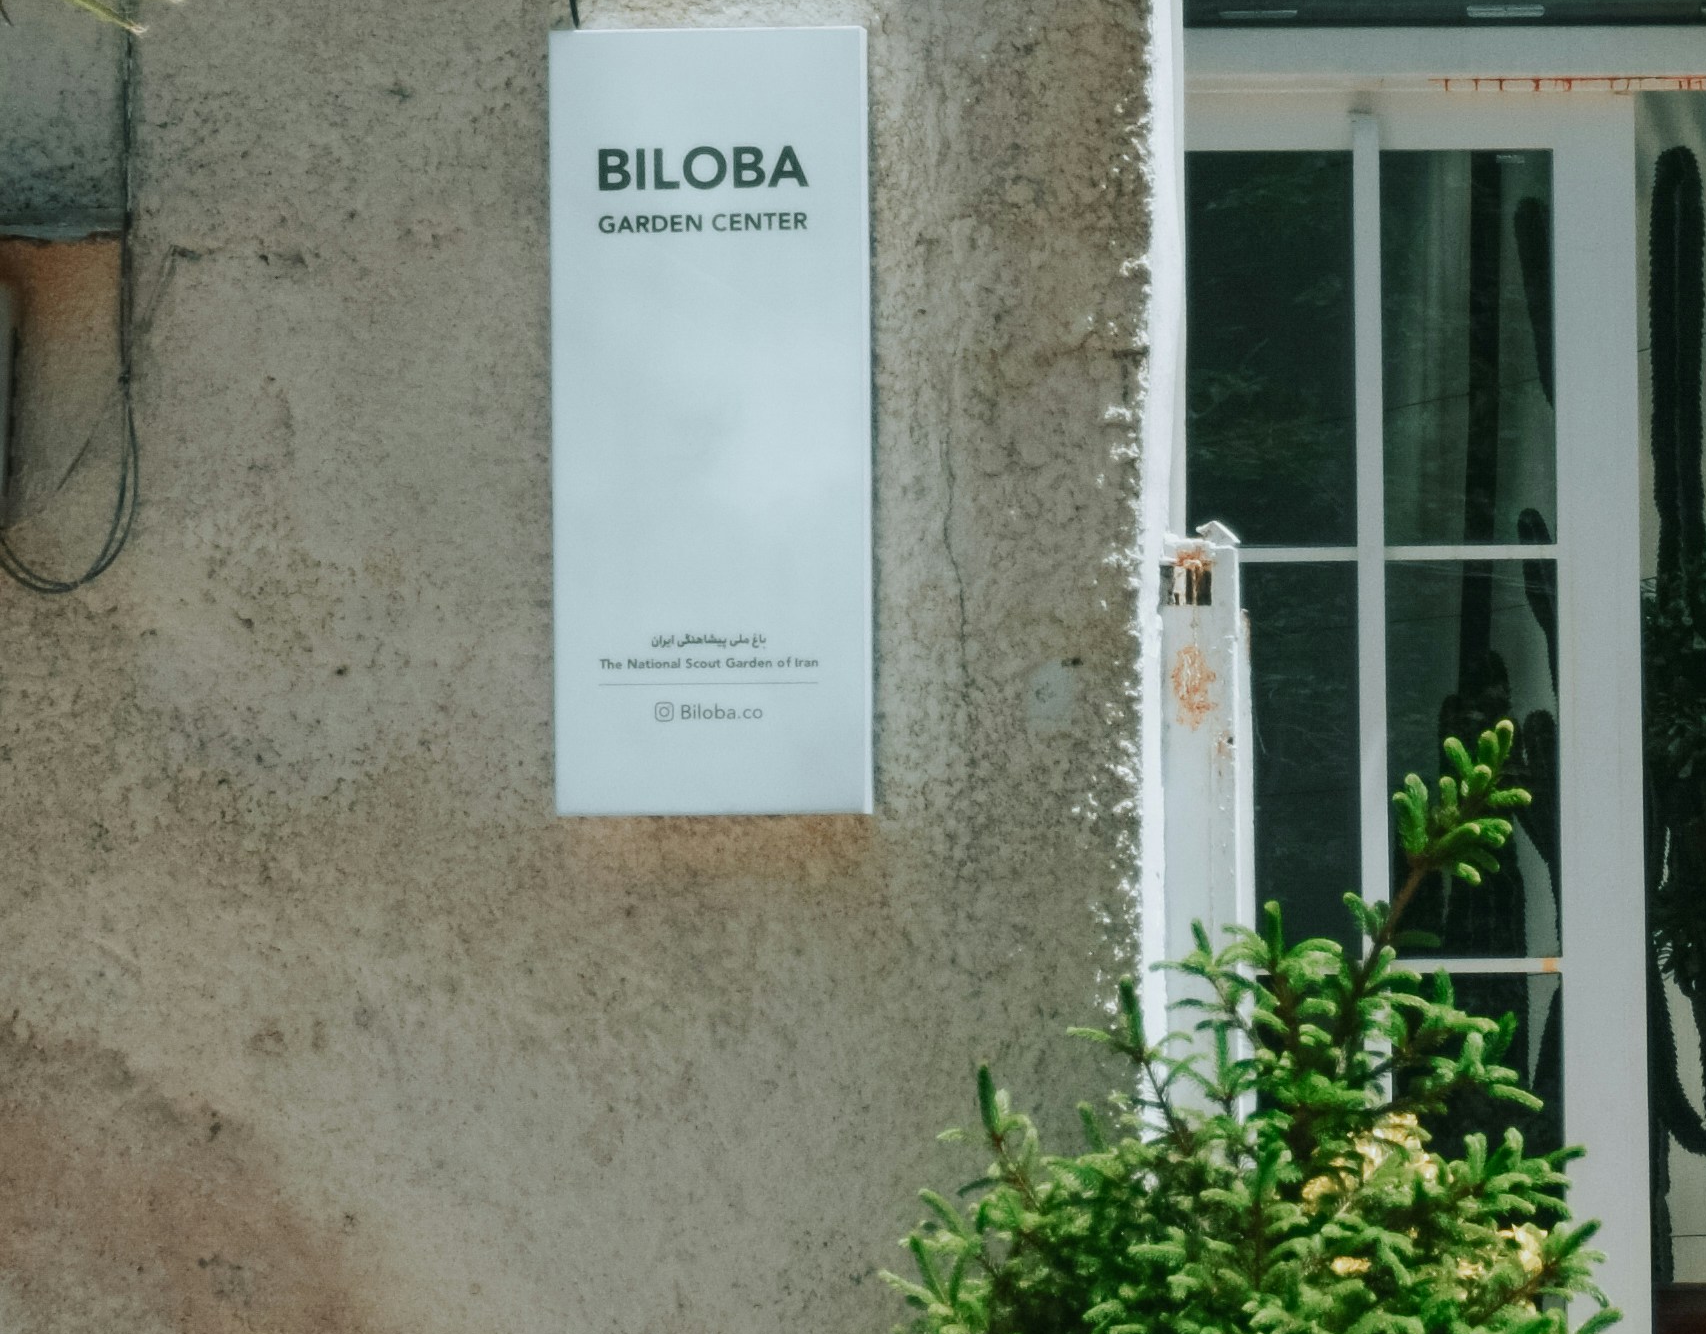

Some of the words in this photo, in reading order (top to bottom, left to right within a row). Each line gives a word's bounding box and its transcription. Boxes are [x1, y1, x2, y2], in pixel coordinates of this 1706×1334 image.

[598, 145, 809, 191] BILOBA
[598, 214, 703, 235] GARDEN
[711, 212, 809, 233] CENTER
[651, 634, 675, 649] ایران
[676, 633, 728, 649] پیشاهنگی
[729, 633, 750, 648] ملی
[751, 633, 767, 649] باغ
[599, 658, 623, 670] The
[627, 657, 681, 670] National
[685, 657, 721, 669] Scout
[725, 657, 773, 669] Garden
[777, 656, 792, 668] of
[795, 657, 819, 668] Iran
[680, 703, 764, 721] Biloba.co
